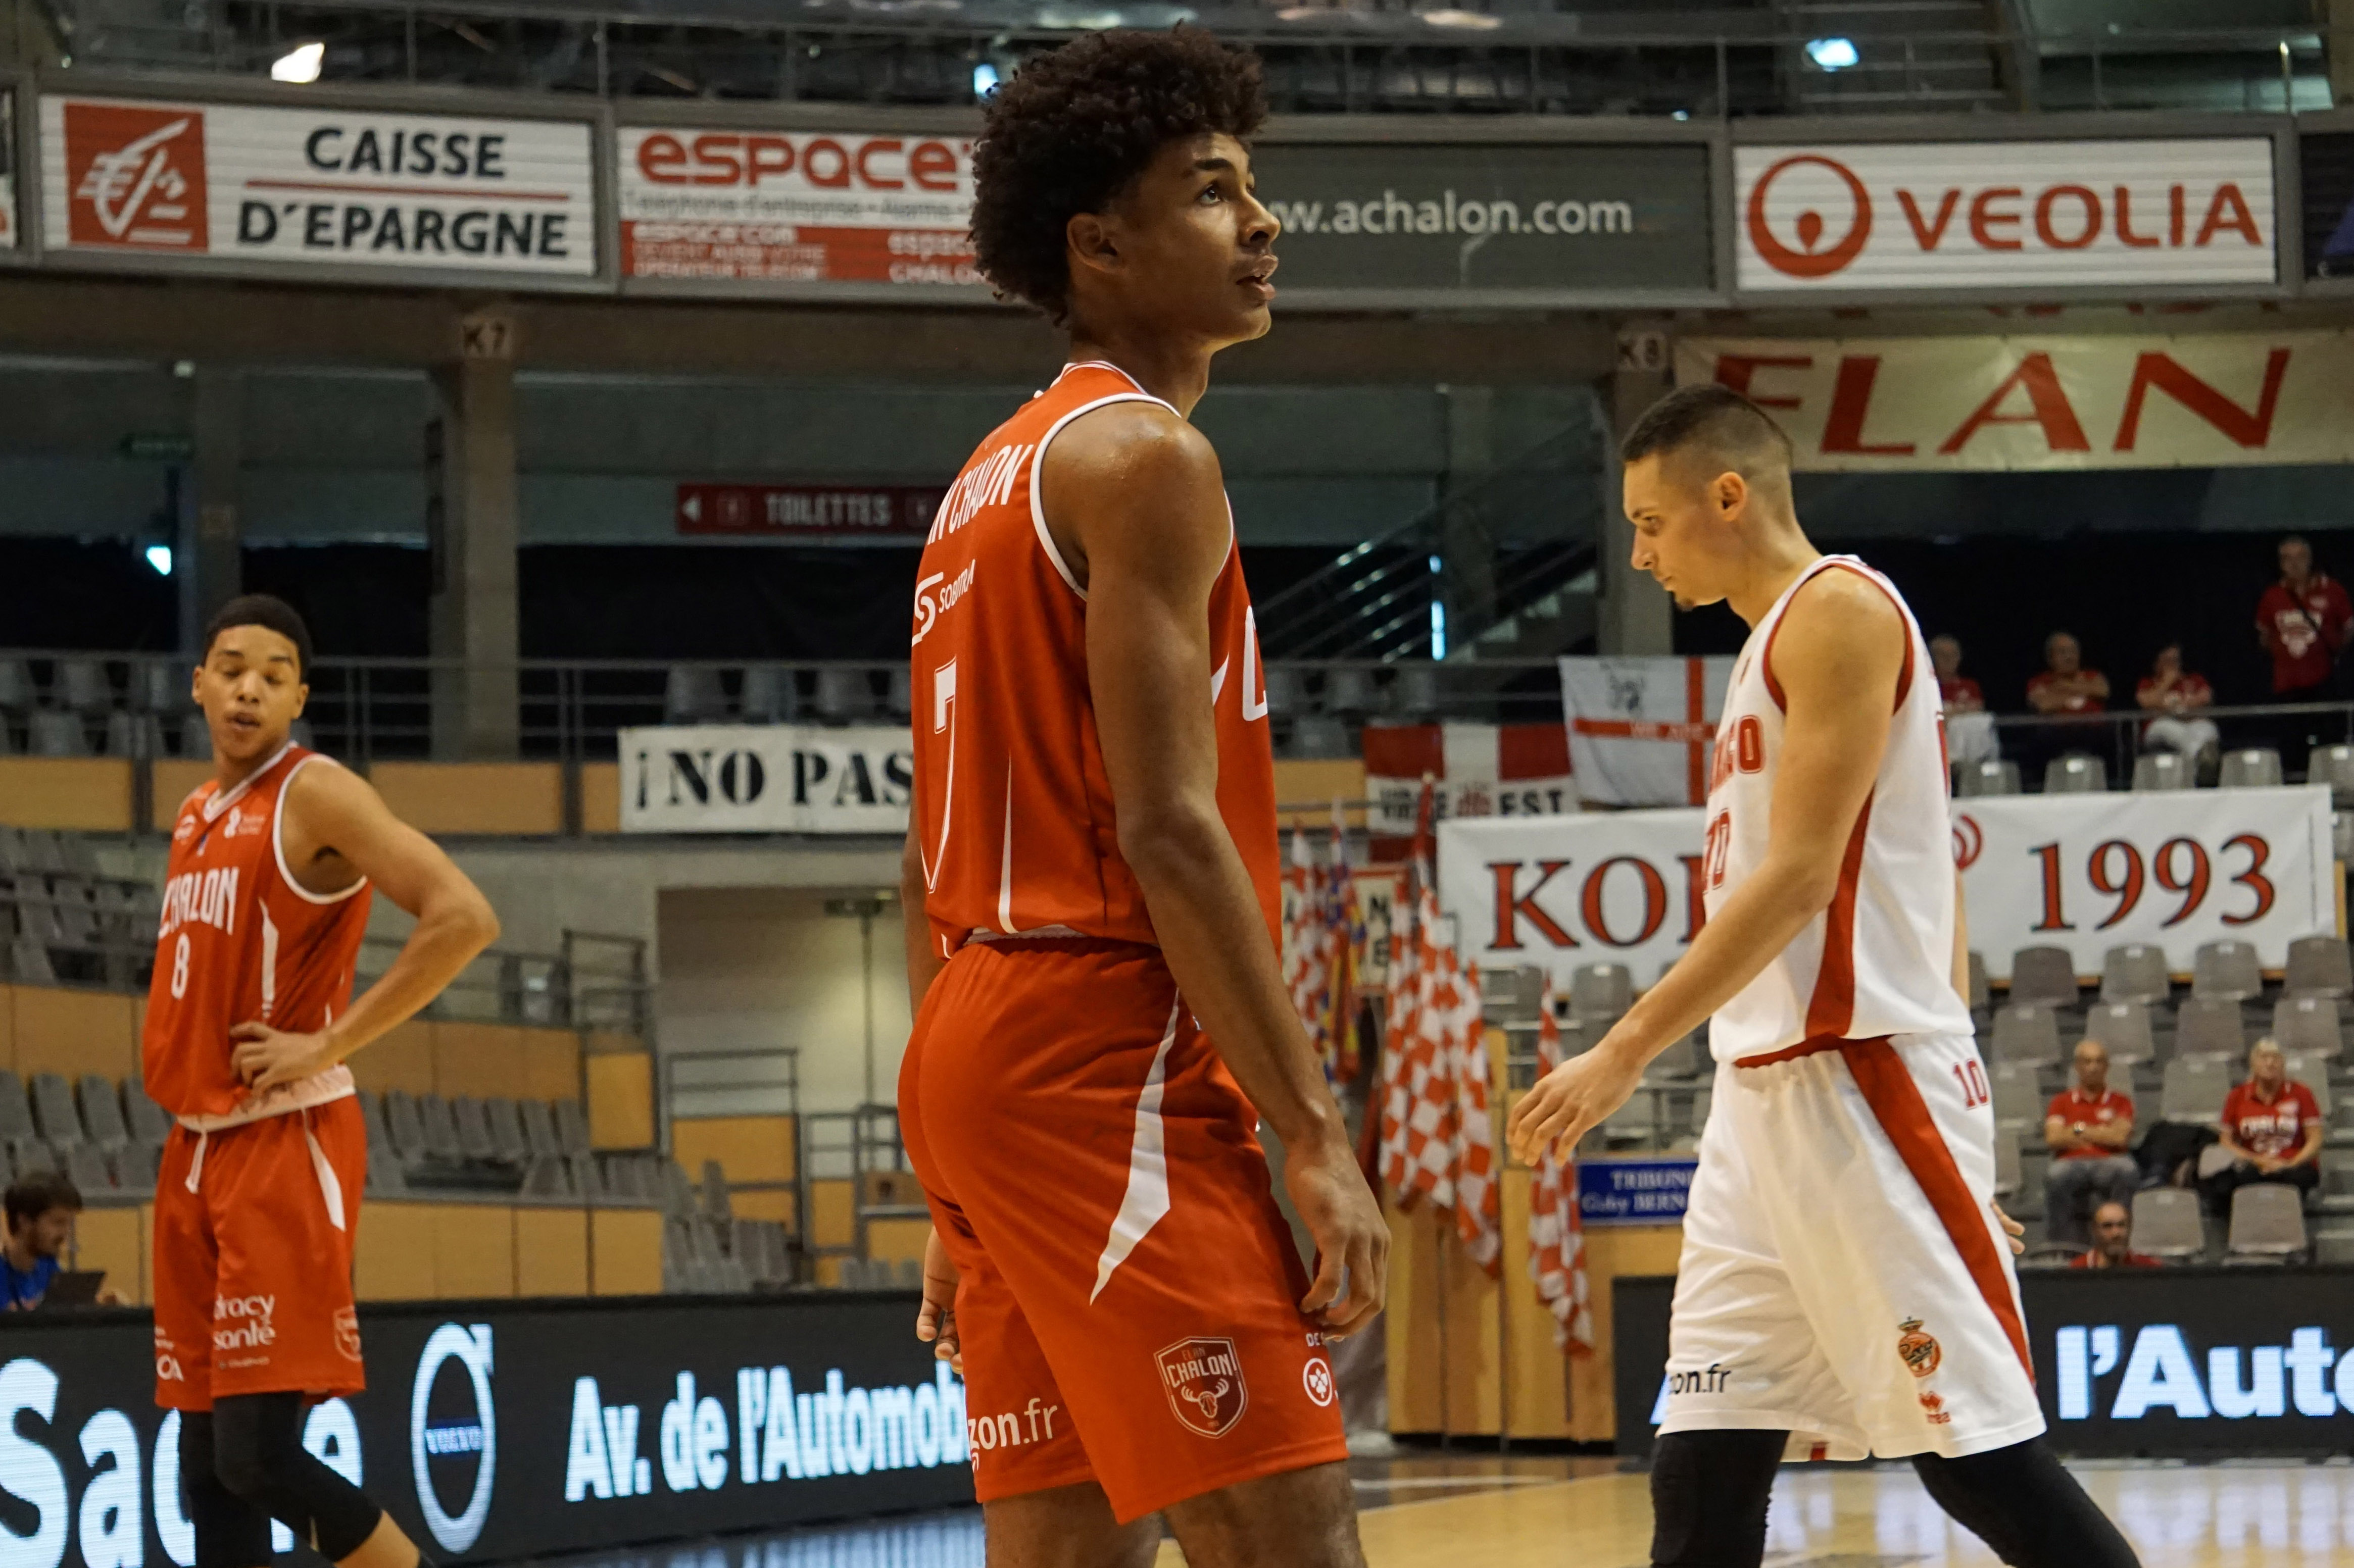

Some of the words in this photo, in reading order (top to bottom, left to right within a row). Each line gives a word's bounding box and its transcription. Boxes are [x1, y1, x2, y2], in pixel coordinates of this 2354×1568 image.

[305, 127, 507, 177] CAISSE
[638, 133, 957, 191] espace
[236, 201, 568, 257] D'EPARGNE
[1895, 182, 2263, 250] VEOLIA
[949, 444, 1034, 534] CHALON
[158, 867, 239, 939] CHALON
[2029, 833, 2276, 932] 1993
[171, 933, 190, 999] 8
[1952, 1058, 1990, 1110] 10
[1166, 1353, 1233, 1388] CHALON
[1669, 1363, 1732, 1395] on.fr
[565, 1376, 652, 1502] Av.
[660, 1370, 729, 1492] de
[737, 1358, 971, 1484] l'Automob
